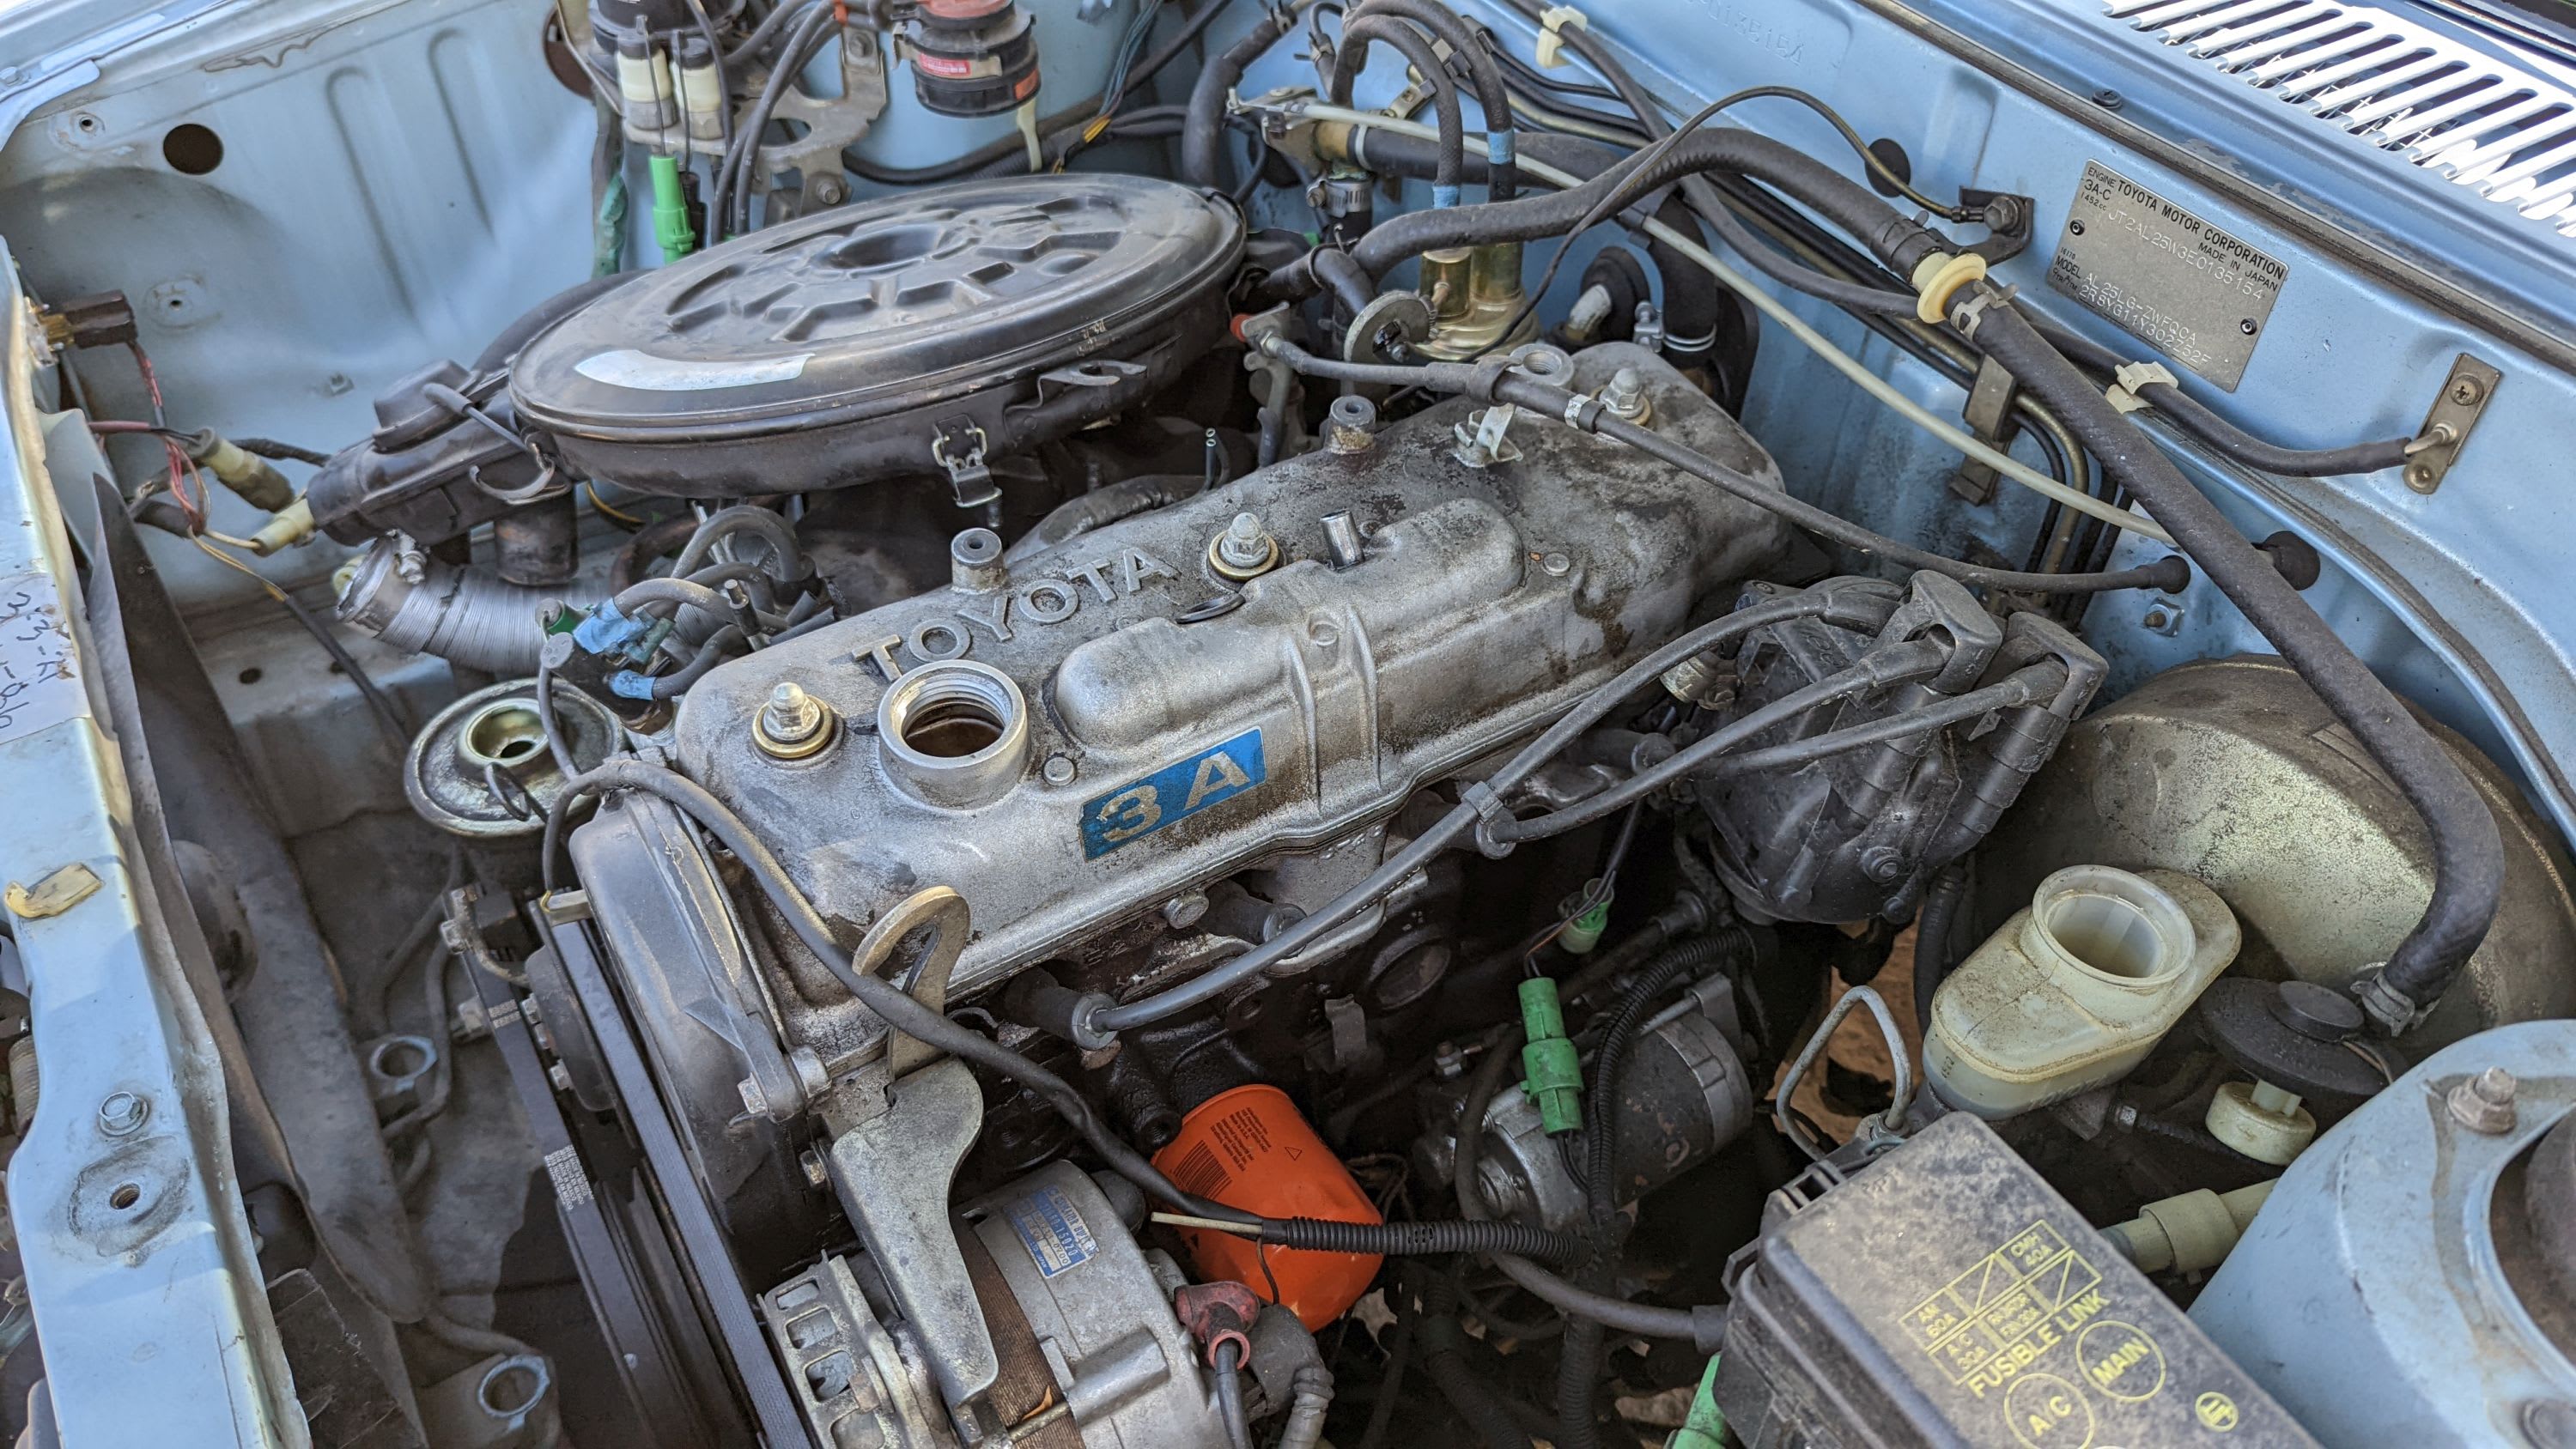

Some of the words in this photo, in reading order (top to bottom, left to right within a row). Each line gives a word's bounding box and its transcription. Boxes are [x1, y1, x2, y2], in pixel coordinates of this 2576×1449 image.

[2083, 179, 2111, 201] 3A-C
[2087, 167, 2117, 187] ENGINE
[2117, 179, 2157, 211] TOYOTA
[2161, 204, 2201, 234] MOTOR
[2203, 228, 2284, 280] CORPORATION
[2055, 255, 2081, 279] MODEL
[2198, 242, 2226, 263] MADE
[2229, 259, 2241, 271] IN
[2245, 269, 2277, 292] JAPAN
[851, 545, 1182, 684] TOYOTA
[1968, 1324, 2063, 1399] FUSIBLE
[2055, 1288, 2111, 1332] LINK
[2091, 1337, 2149, 1386] MAIN
